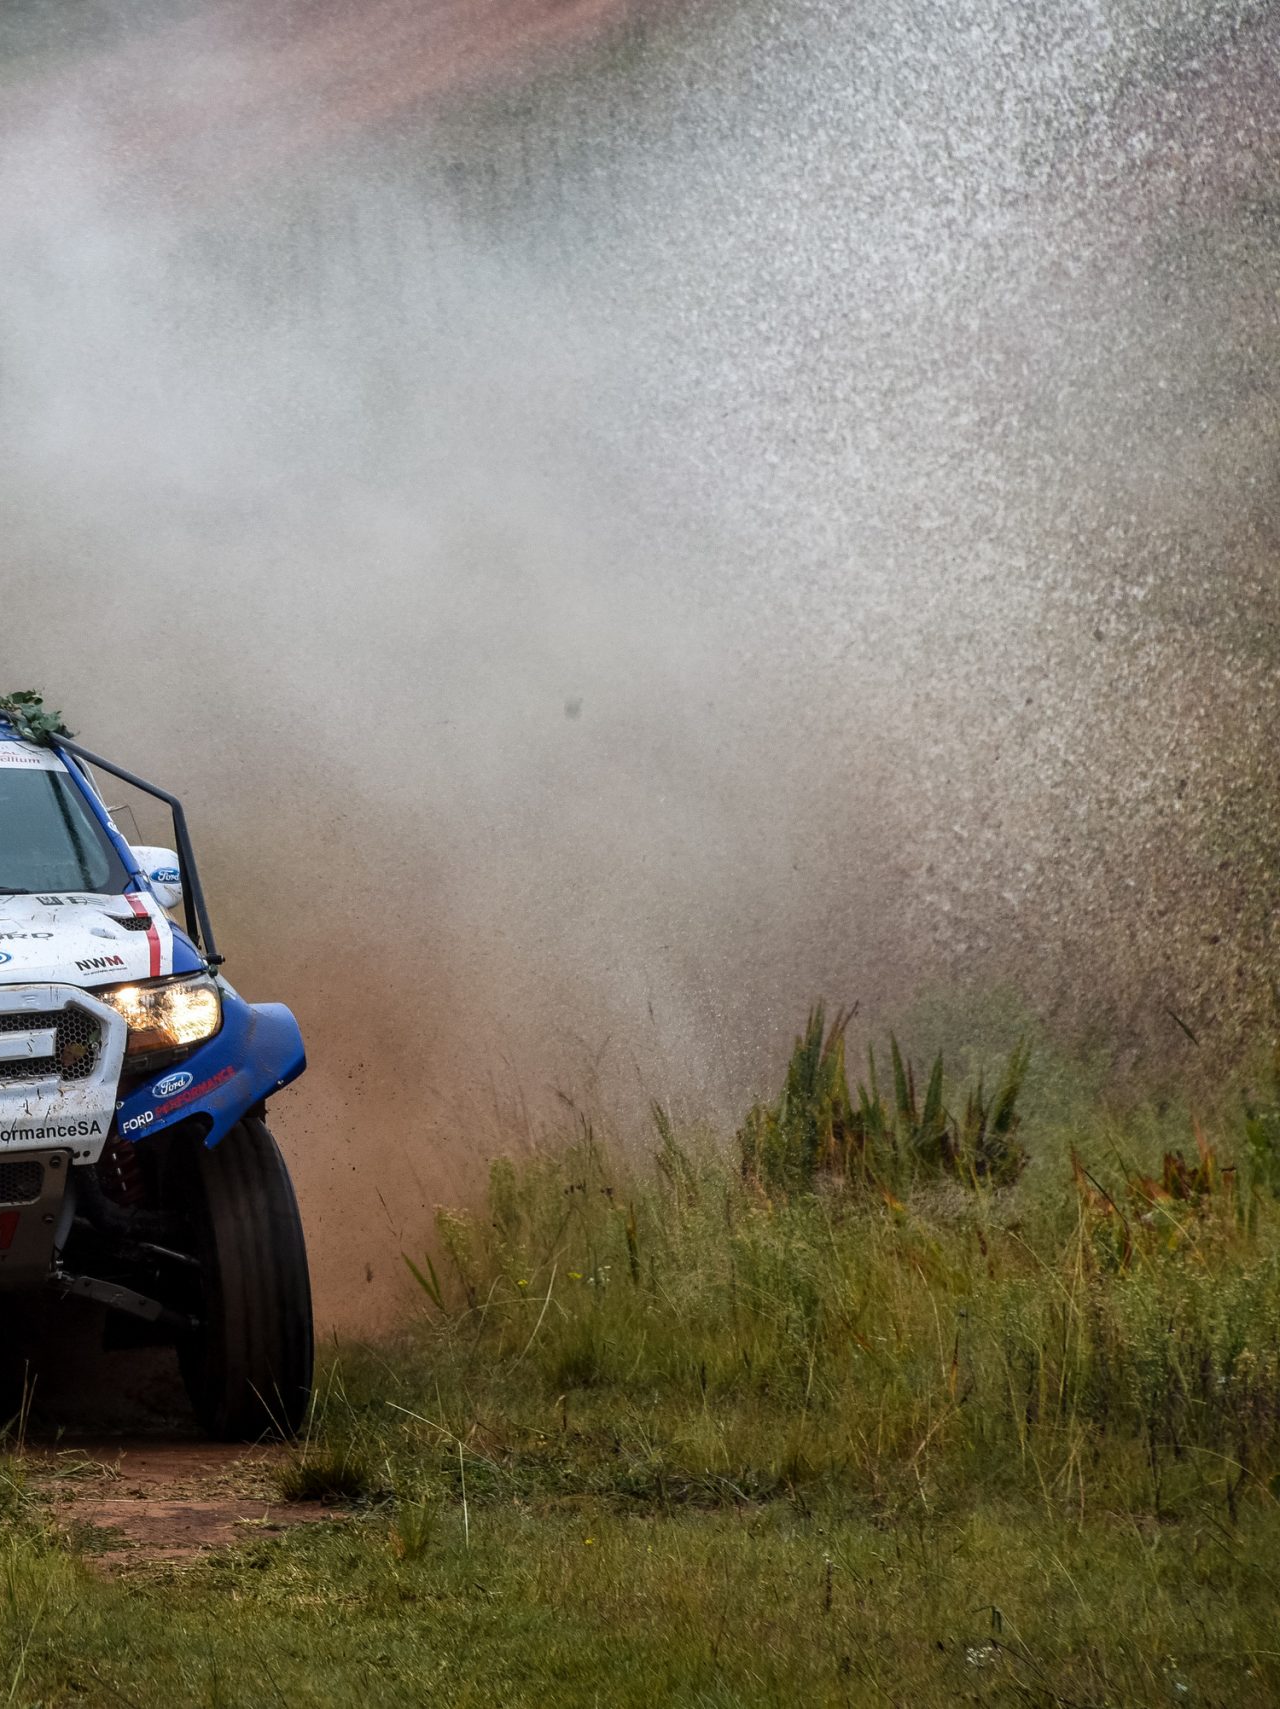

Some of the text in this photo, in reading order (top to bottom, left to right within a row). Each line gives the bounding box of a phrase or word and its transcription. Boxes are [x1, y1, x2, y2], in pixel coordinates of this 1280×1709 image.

[75, 955, 125, 971] NWM
[160, 1077, 186, 1095] Ford
[122, 1065, 236, 1134] FORD PERFORMANCE
